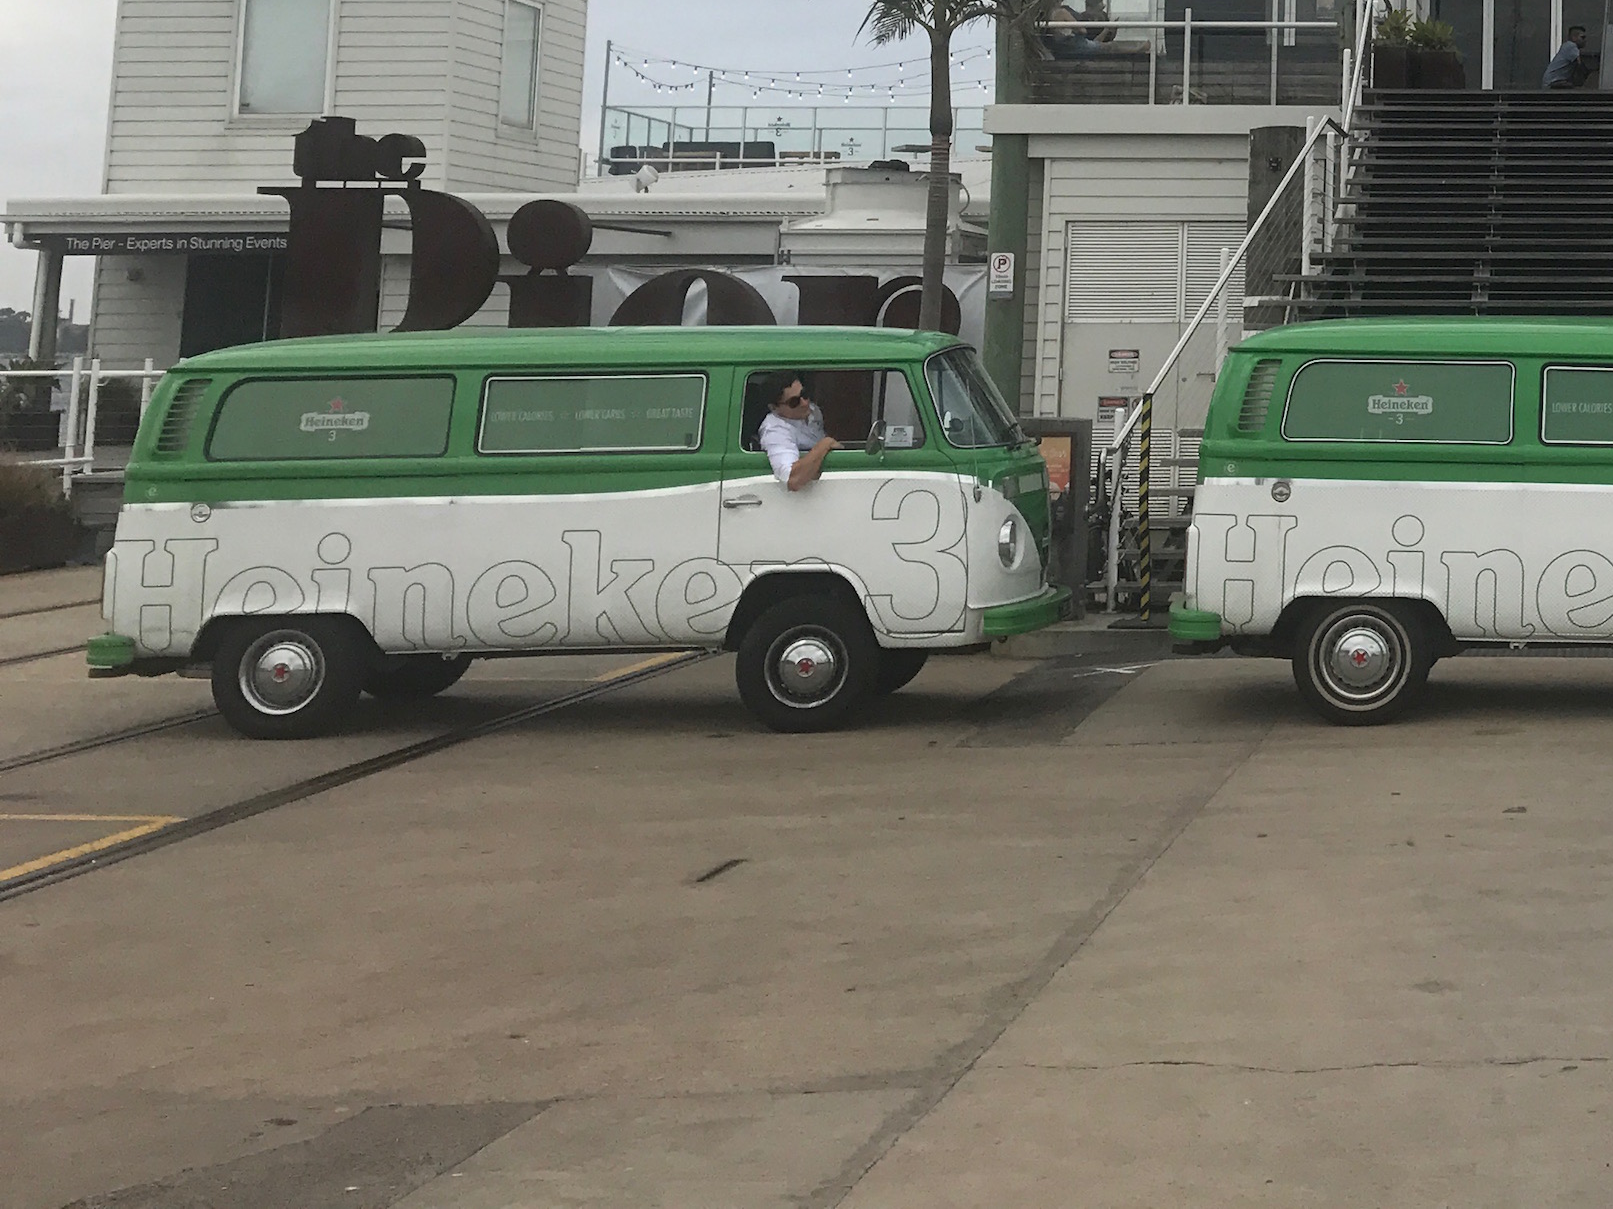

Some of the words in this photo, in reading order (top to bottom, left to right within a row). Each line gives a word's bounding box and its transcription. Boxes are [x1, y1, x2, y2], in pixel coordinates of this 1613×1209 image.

[66, 237, 89, 250] The
[92, 237, 115, 250] Pier
[127, 236, 173, 252] Experts
[176, 237, 188, 249] in
[190, 236, 243, 252] Stunning
[245, 236, 288, 250] Events
[1372, 398, 1429, 410] Heineken
[1552, 402, 1577, 414] LOWER
[1578, 402, 1613, 414] CALORIES
[670, 407, 694, 418] TASTE
[304, 415, 364, 428] Heineken
[1395, 413, 1404, 425] 3
[327, 430, 337, 442] 3
[111, 530, 834, 651] Heineke
[864, 477, 969, 639] 3
